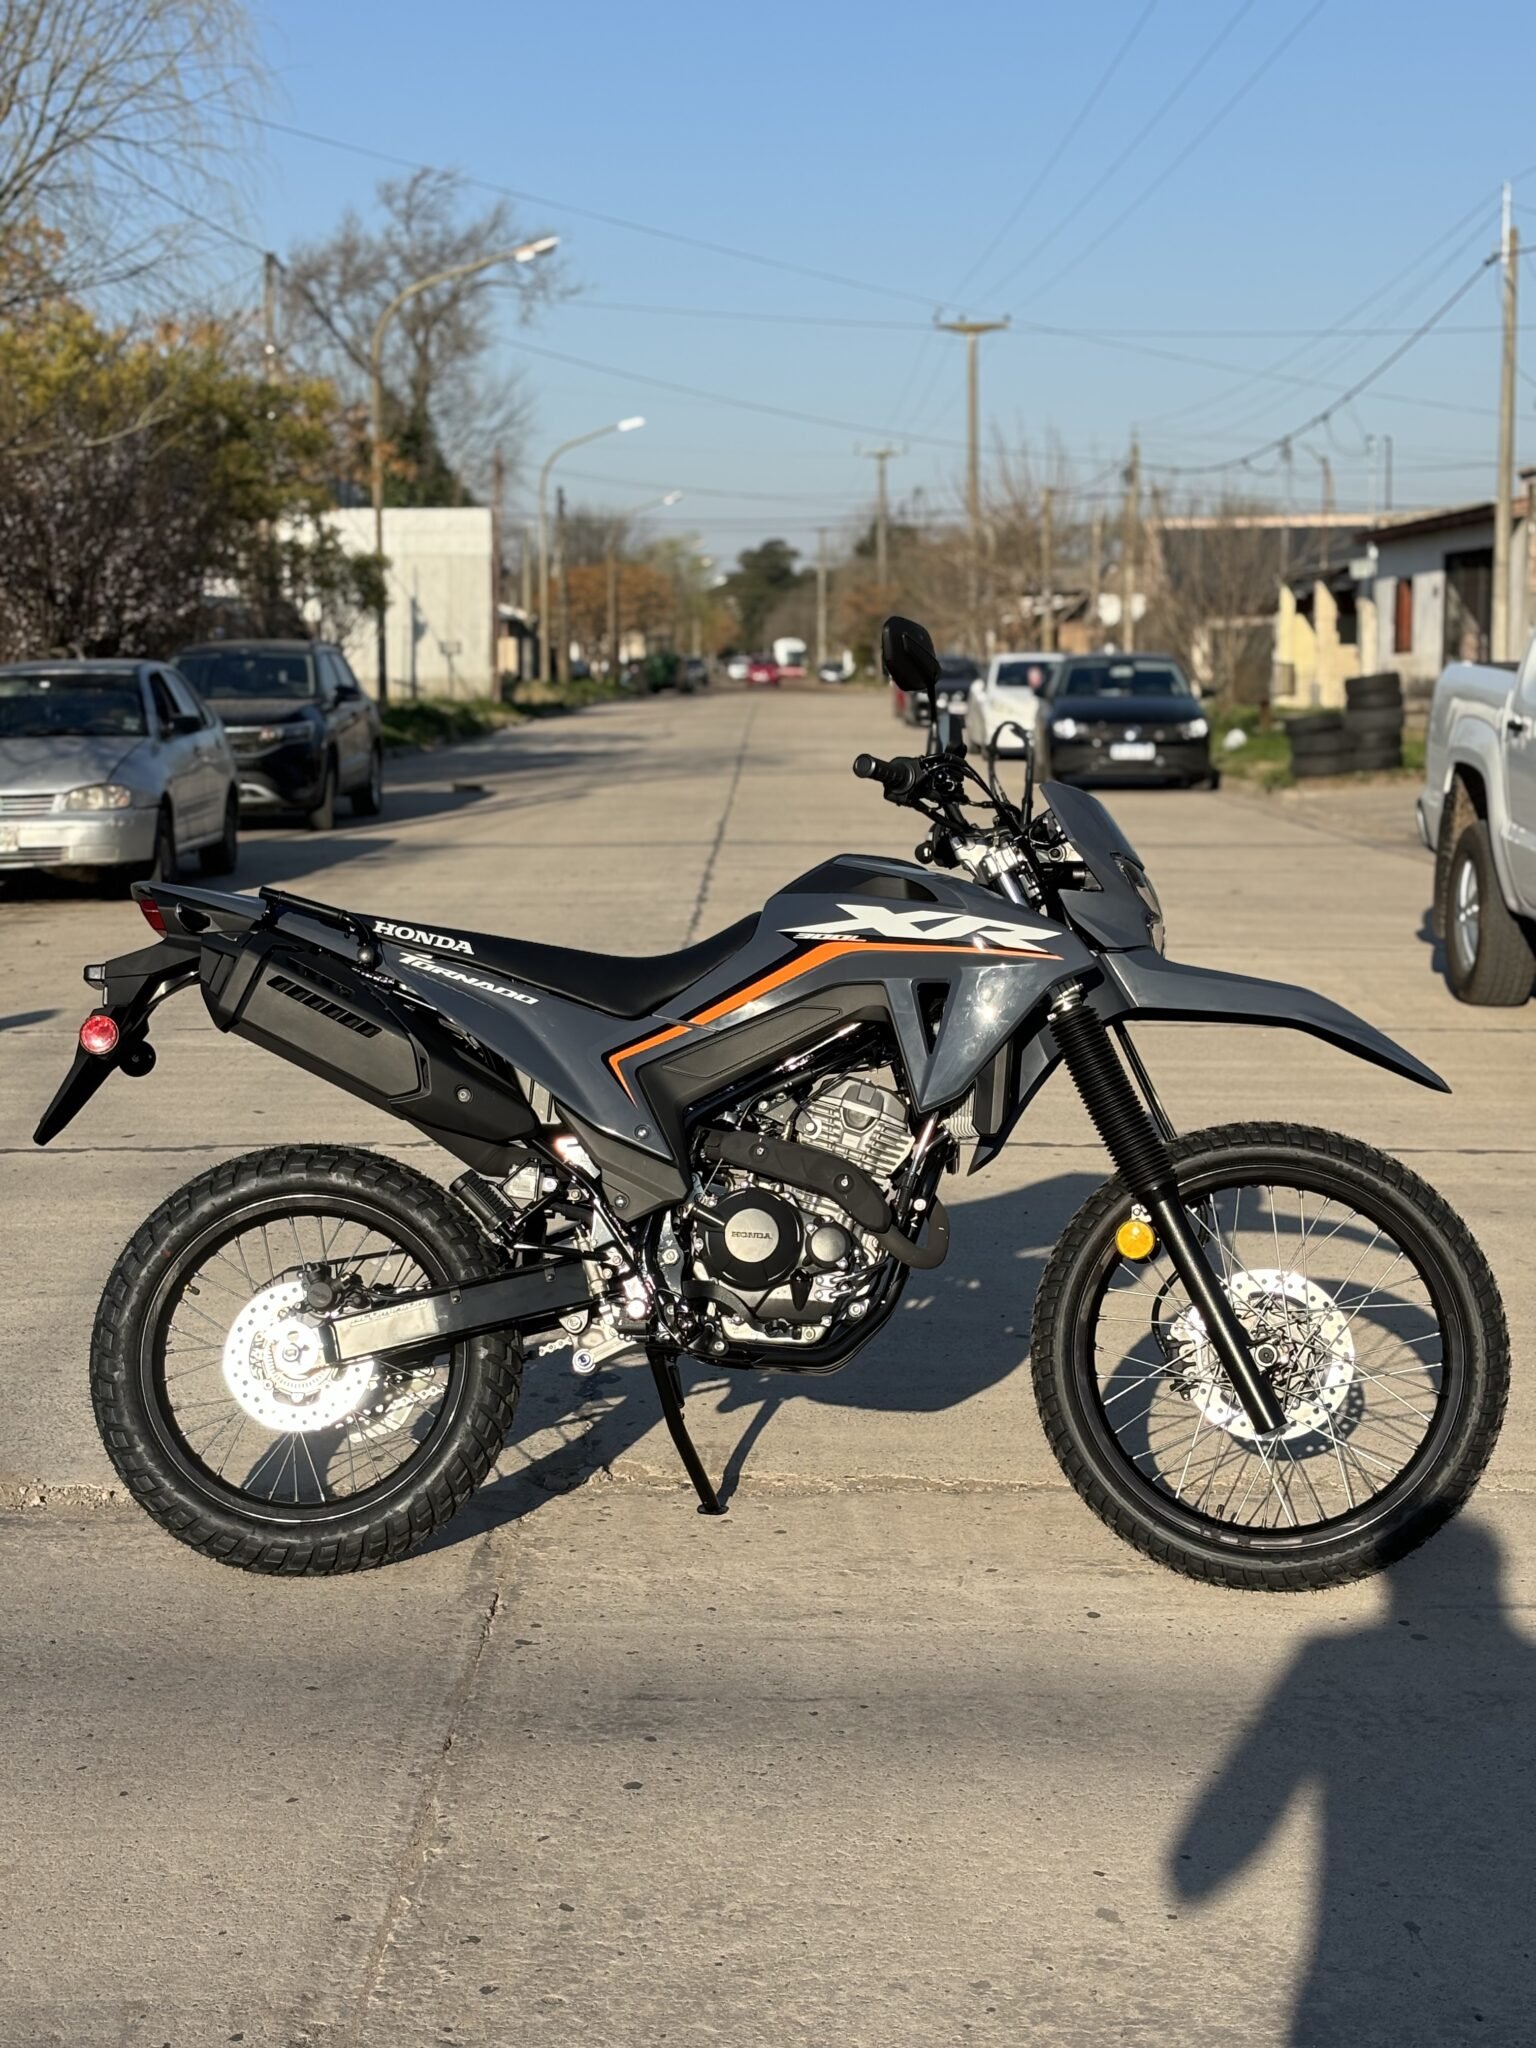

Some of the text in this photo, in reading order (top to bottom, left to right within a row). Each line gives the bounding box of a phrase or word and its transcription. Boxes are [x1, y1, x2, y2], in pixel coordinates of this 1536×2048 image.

[372, 920, 475, 956] HONDA
[776, 903, 1063, 953] XR
[793, 932, 867, 943] 300L
[398, 952, 540, 1006] TORNADO
[731, 1231, 773, 1240] HONDA
